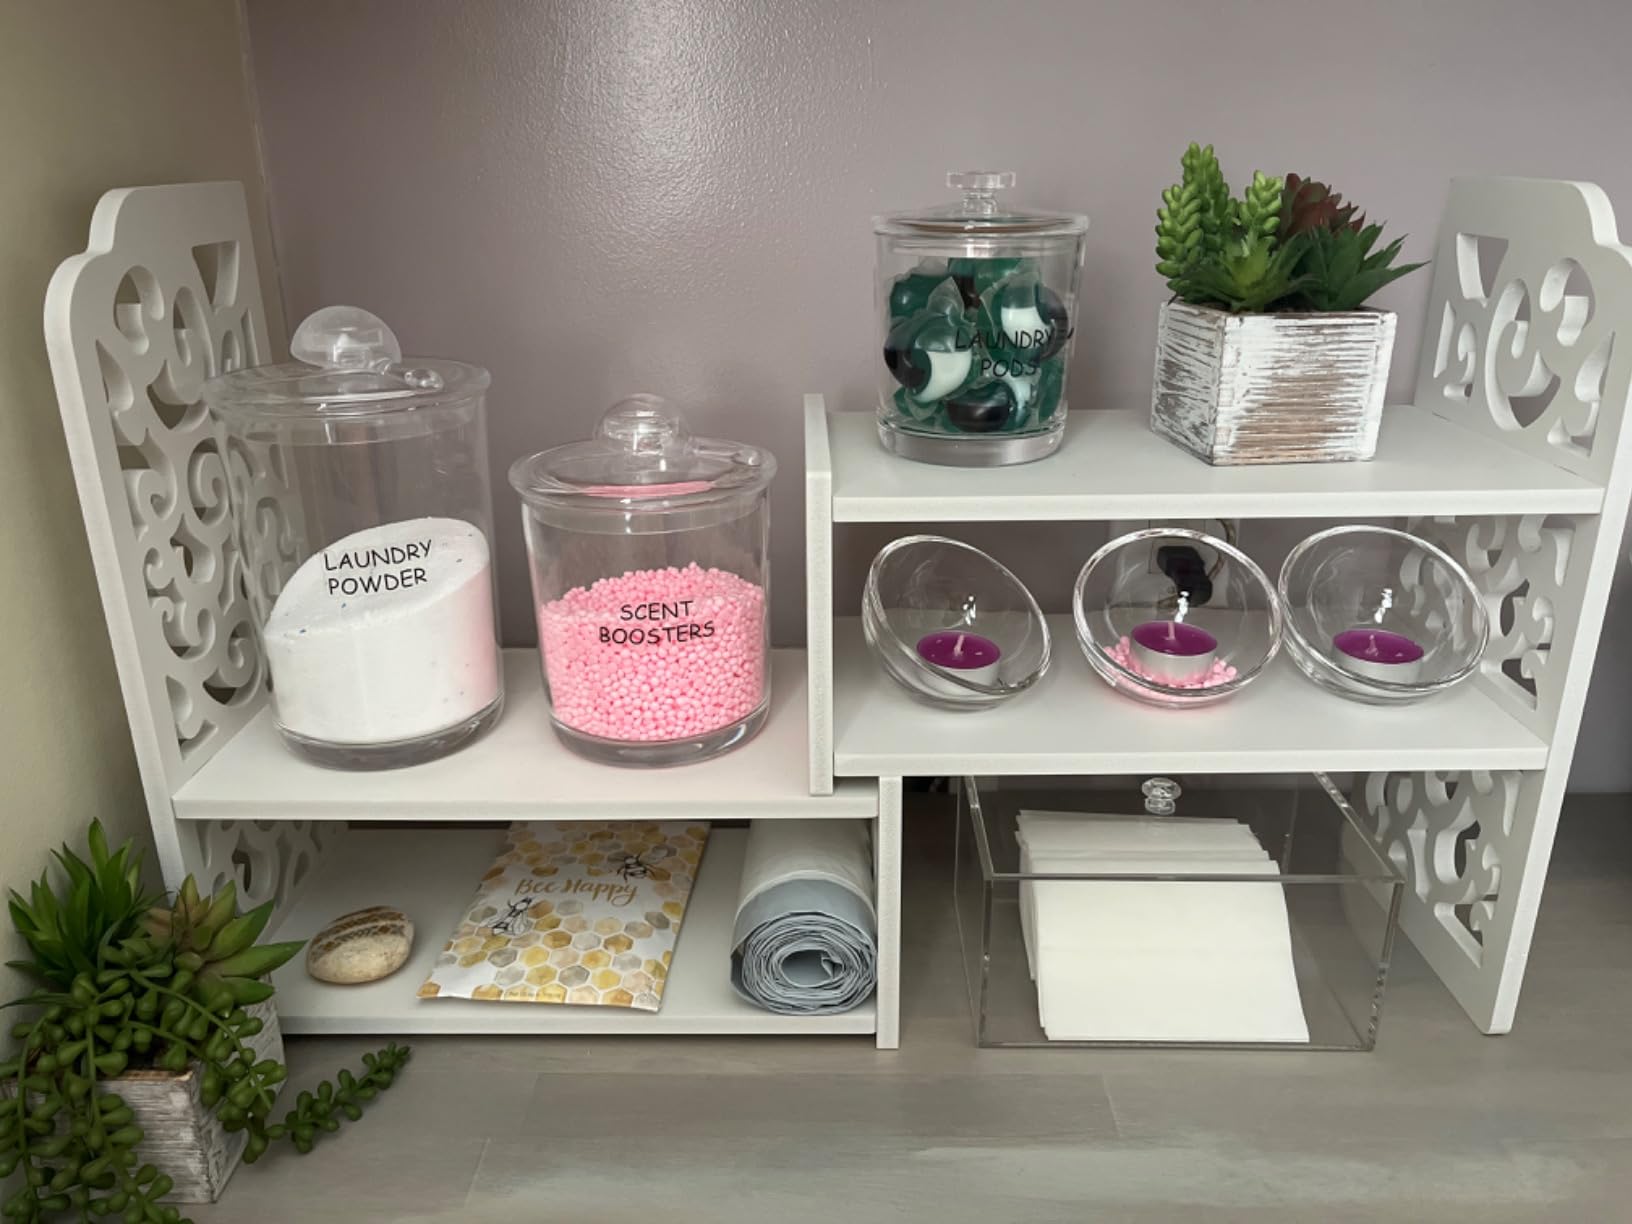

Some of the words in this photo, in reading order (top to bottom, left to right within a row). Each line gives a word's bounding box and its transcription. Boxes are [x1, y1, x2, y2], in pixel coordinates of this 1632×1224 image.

[955, 327, 1056, 349] LAUNDRY
[981, 358, 1037, 378] PODS
[323, 539, 432, 571] LAUNDRY
[328, 567, 428, 595] POWDER
[620, 600, 694, 621] SCENT
[599, 620, 715, 645] BOOSTERS
[514, 878, 556, 896] Bee
[560, 878, 638, 907] Happy
